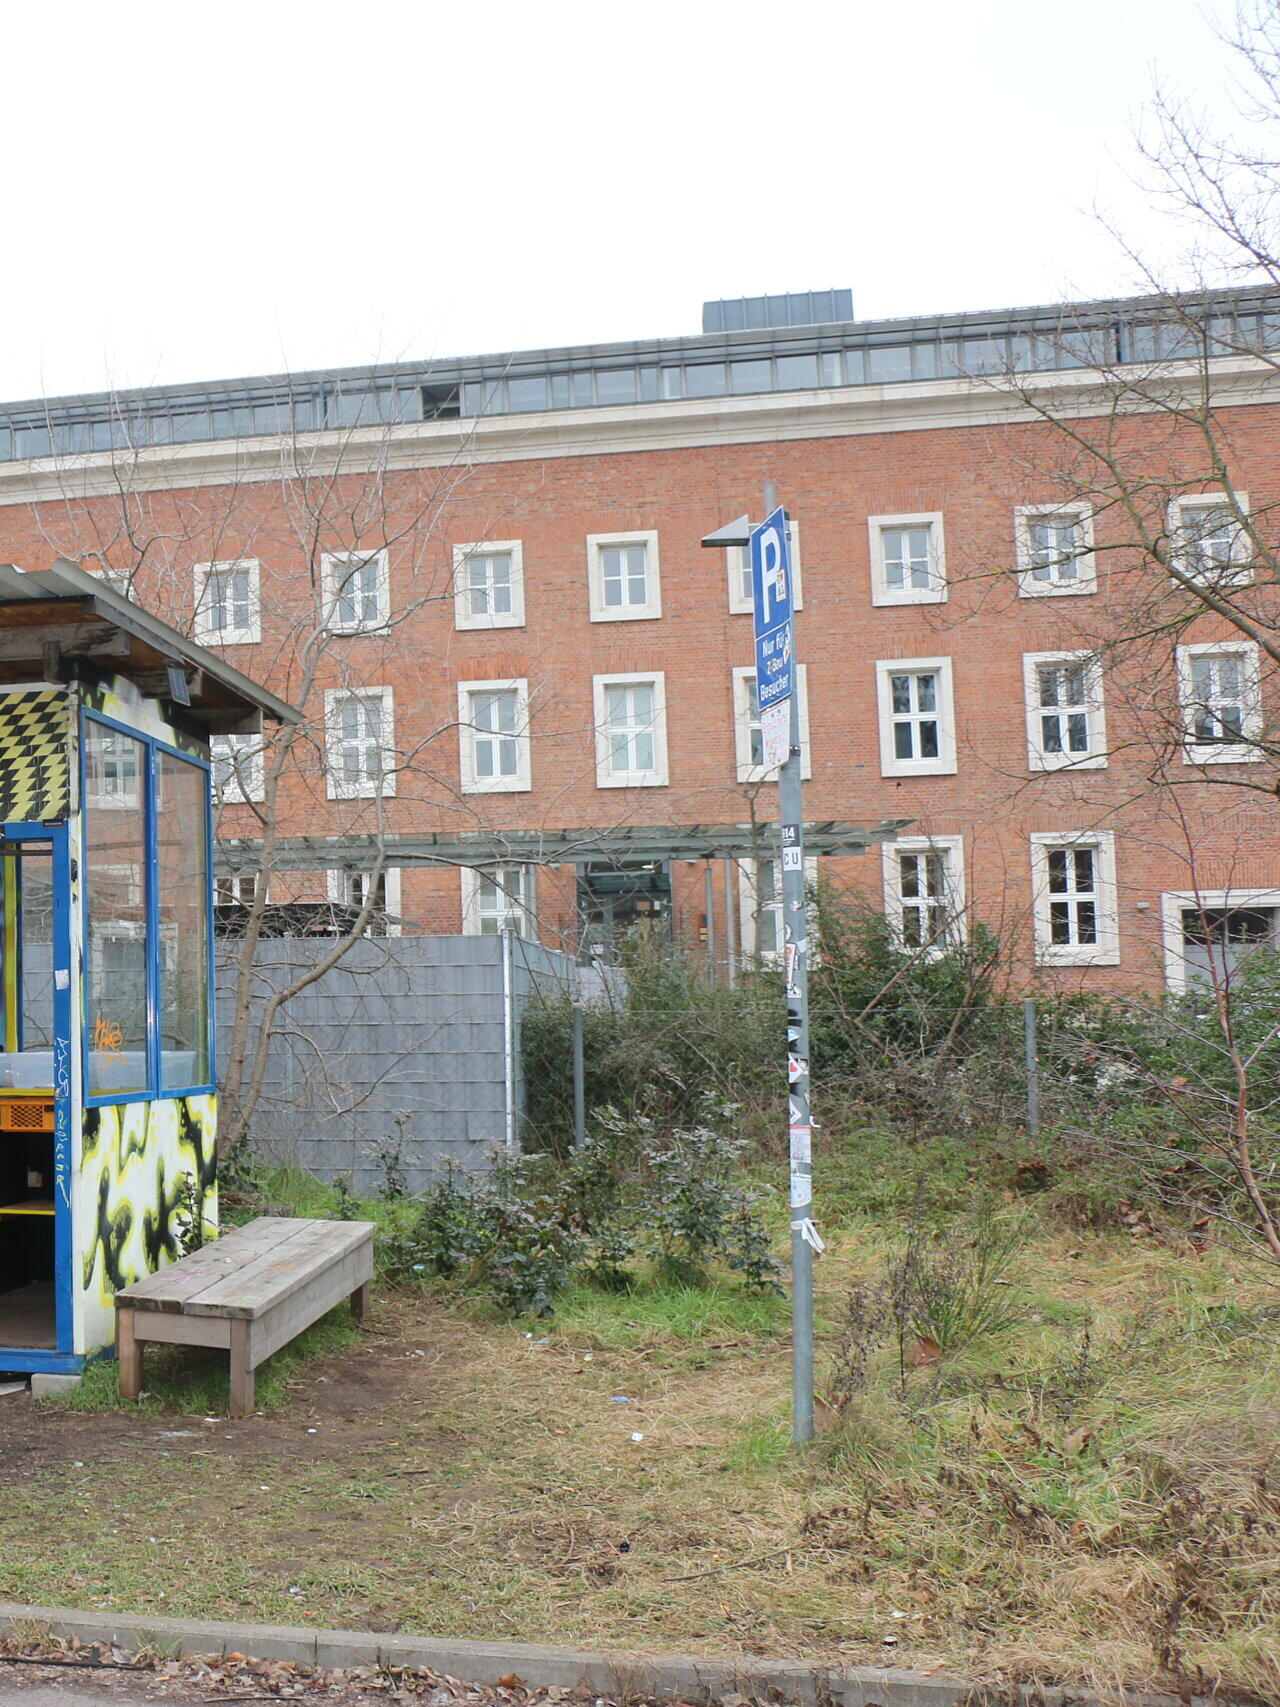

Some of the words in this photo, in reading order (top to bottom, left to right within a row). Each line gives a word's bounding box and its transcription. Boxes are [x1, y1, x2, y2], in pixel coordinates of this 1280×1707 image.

[760, 526, 781, 624] P
[762, 639, 775, 658] Nur
[760, 673, 789, 701] Besucher
